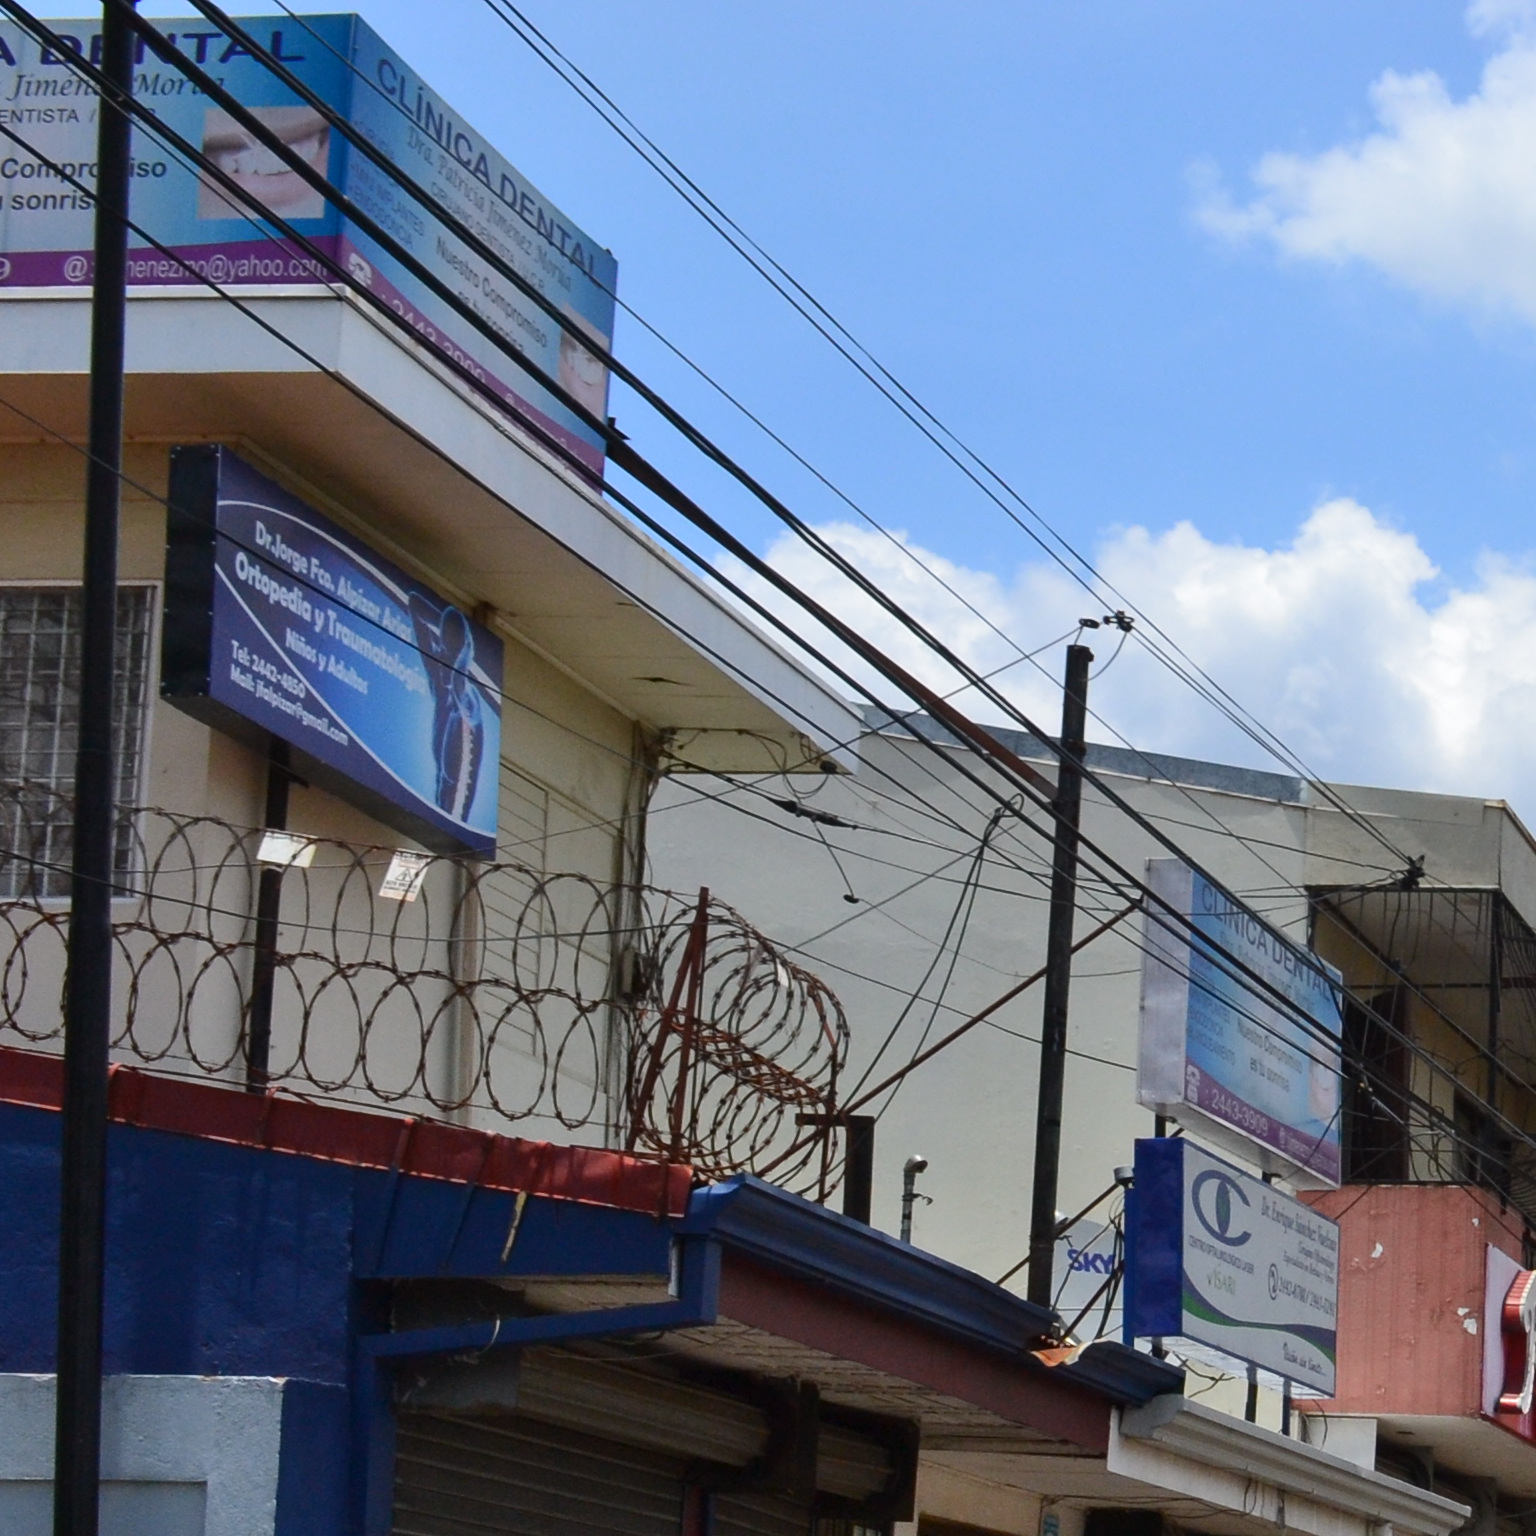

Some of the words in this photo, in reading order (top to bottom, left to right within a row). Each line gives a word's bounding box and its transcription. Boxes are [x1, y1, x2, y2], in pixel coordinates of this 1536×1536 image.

[40, 31, 306, 65] DNTAL
[6, 73, 101, 101] Jimén
[0, 108, 80, 124] ENTISTA
[1, 157, 167, 183] Comproiso
[11, 188, 99, 211] sonris
[234, 547, 312, 626] Ortopedia
[1067, 1248, 1116, 1275] SKY
